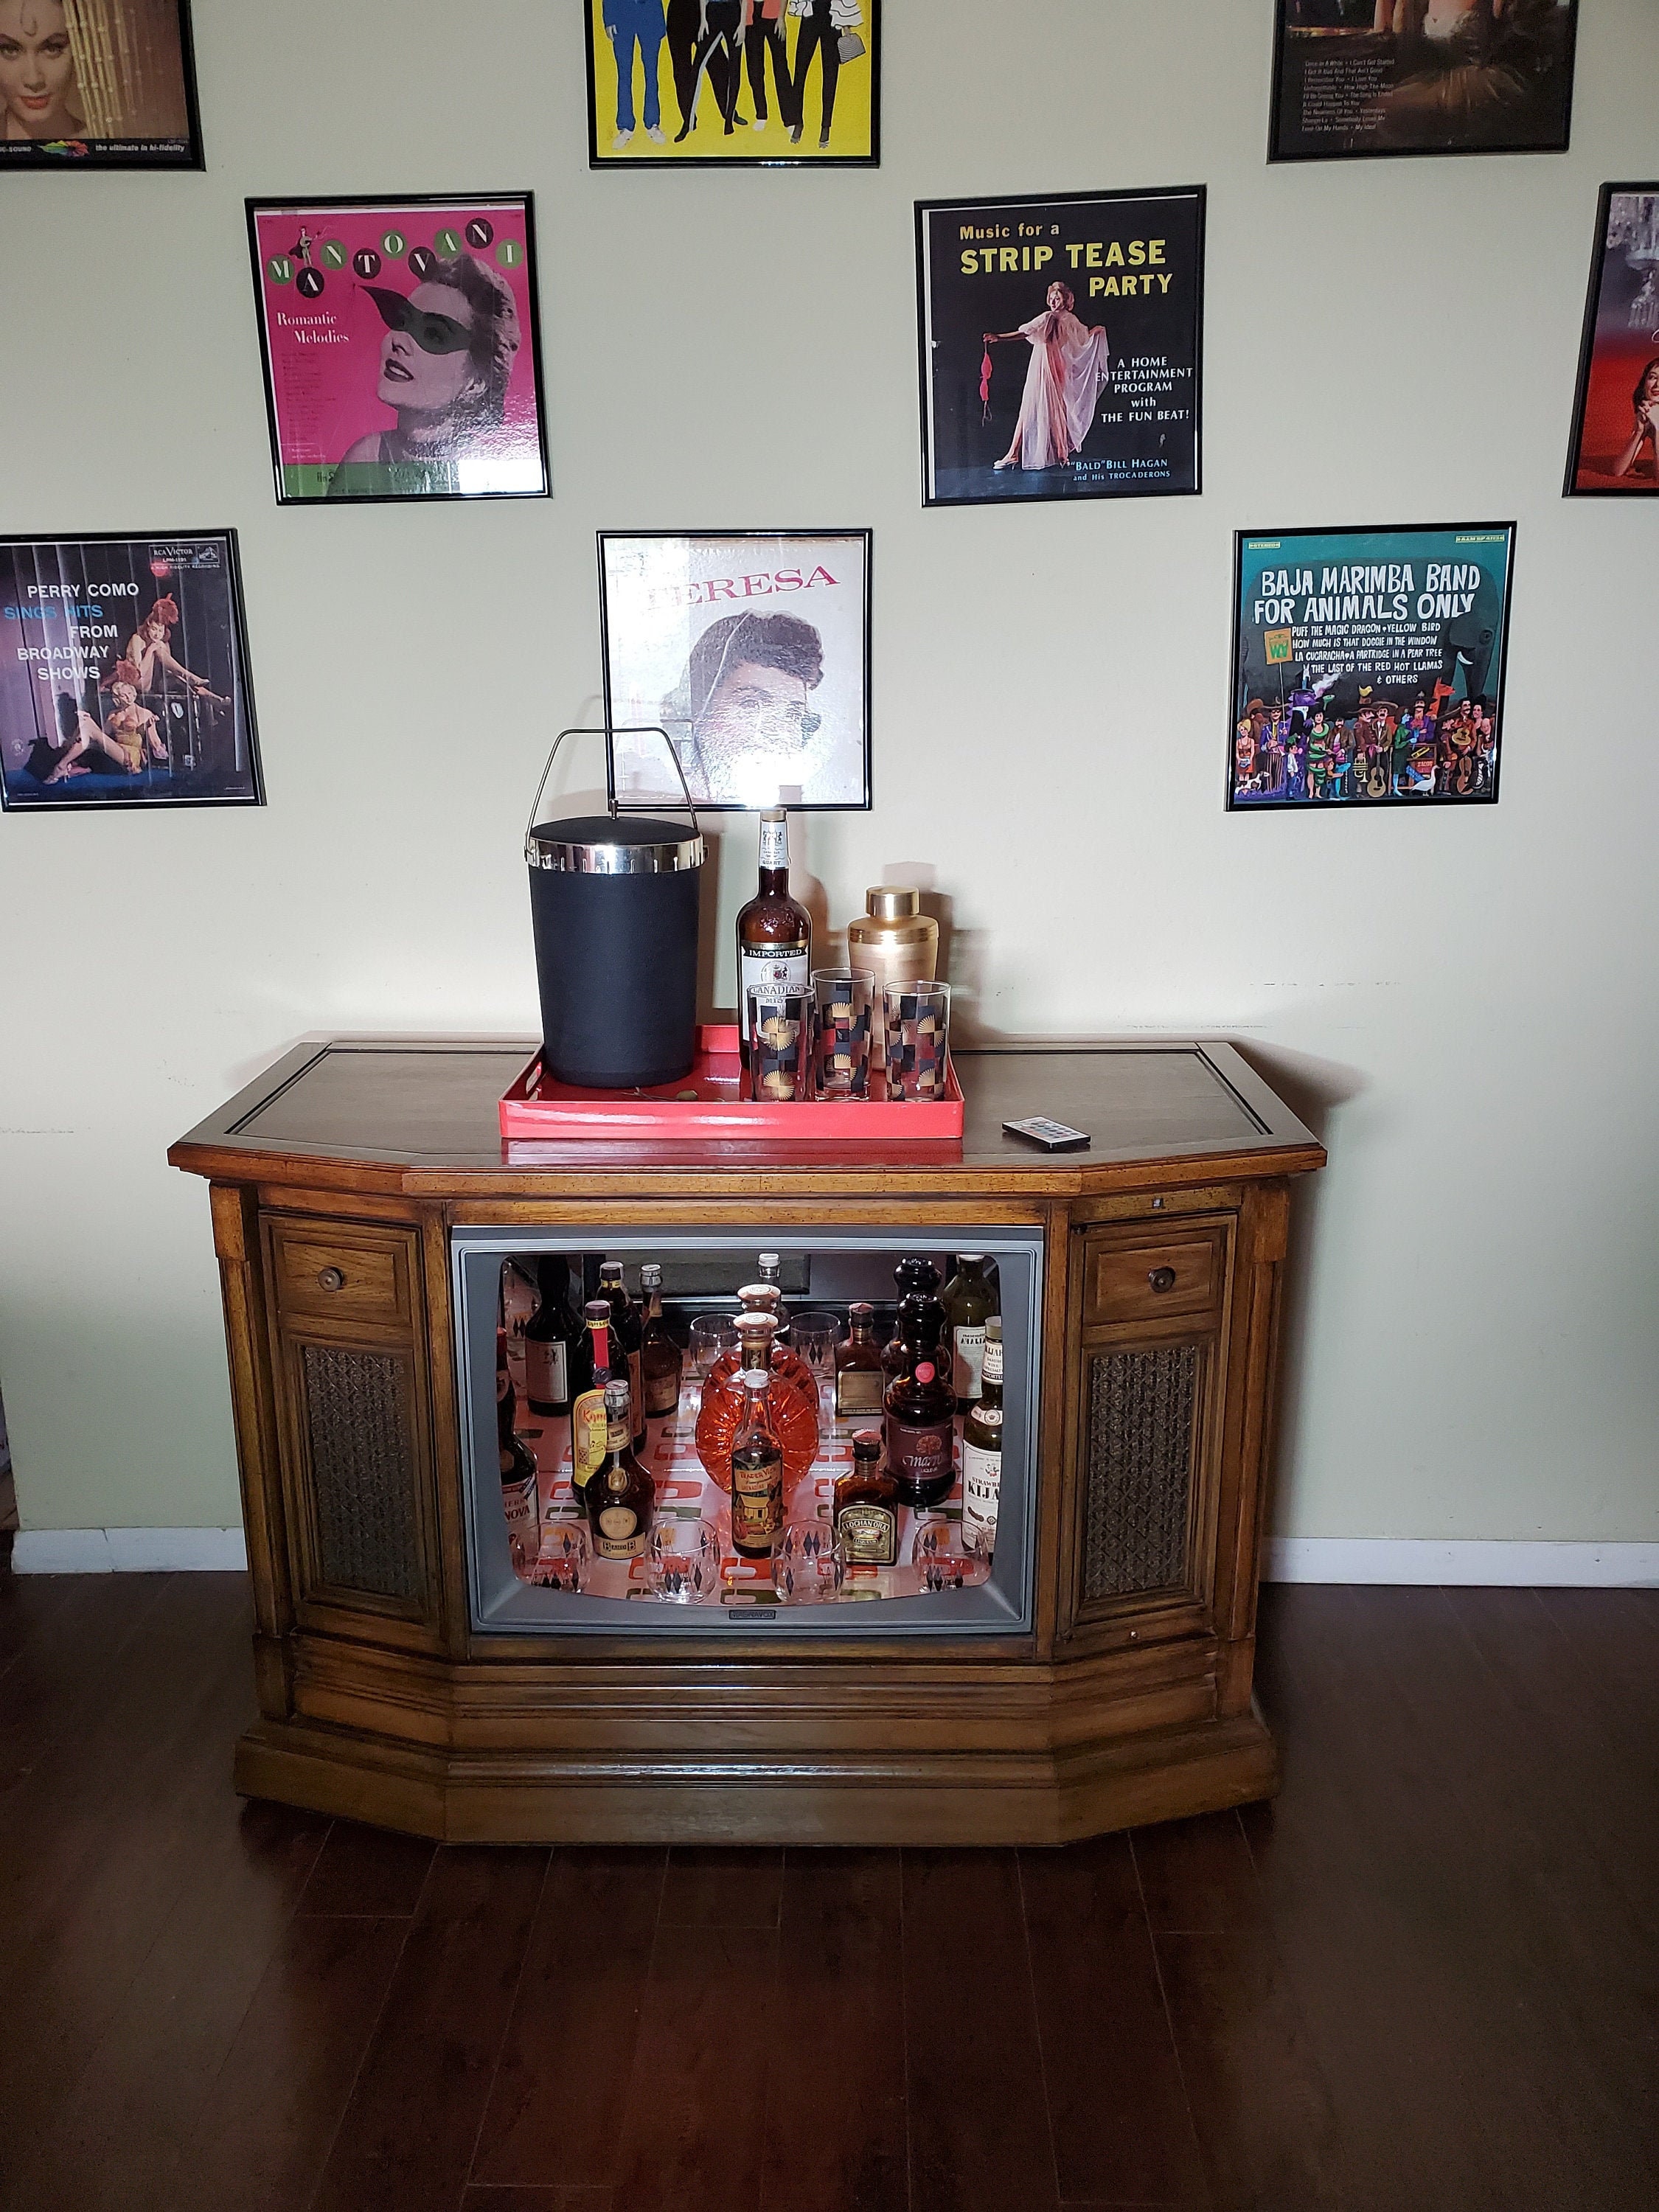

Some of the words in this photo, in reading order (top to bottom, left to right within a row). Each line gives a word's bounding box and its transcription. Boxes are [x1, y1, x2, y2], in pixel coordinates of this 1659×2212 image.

[960, 224, 1010, 240] Music
[1018, 223, 1043, 237] for
[1051, 223, 1060, 235] a
[960, 246, 1054, 274] STRIP
[1065, 240, 1166, 268] TEASE
[1089, 273, 1173, 296] PARTY
[276, 310, 337, 326] Romantic
[294, 330, 349, 344] Melodies
[1117, 358, 1125, 368] A
[1131, 356, 1168, 368] HOME
[1096, 368, 1193, 382] ENTERTAINMENT
[1114, 382, 1172, 394] PROGRAM
[1131, 397, 1156, 408] with
[1101, 412, 1123, 423] THE
[1129, 411, 1152, 422] FUN
[1158, 409, 1190, 420] BEAT!
[1132, 458, 1168, 468] HAGAN
[1108, 470, 1171, 479] TROCADERONS
[165, 546, 193, 556] VICTOR
[649, 566, 841, 606] ERESA
[1262, 568, 1313, 597] BAJA
[1321, 563, 1415, 595] MARIMBA
[1426, 563, 1481, 592] BAND
[27, 585, 80, 599] PERRY
[87, 582, 139, 598] COMO
[4, 605, 56, 619] SINGS
[1253, 599, 1295, 625] FOR
[1304, 594, 1408, 623] ANIMALS
[1417, 593, 1475, 619] ONLY
[70, 625, 118, 639] FROM
[1292, 626, 1309, 637] PUFF
[1311, 625, 1324, 636] THE
[1324, 624, 1349, 636] MAGIC
[1351, 623, 1381, 634] DRAGON
[1386, 622, 1417, 633] YELLOW
[1421, 622, 1441, 632] BIRD
[1293, 639, 1310, 649] HOW
[1312, 638, 1332, 647] MUCH
[1333, 637, 1341, 647] IS
[1343, 637, 1360, 647] THAT
[1362, 636, 1385, 647] DOGGIE
[1386, 636, 1393, 646] IN
[1394, 636, 1405, 646] THE
[1407, 636, 1438, 646] WINDOW
[17, 645, 110, 661] BROADWAY
[1295, 651, 1304, 662] LA
[1305, 650, 1346, 661] CUCARACHA
[1356, 649, 1390, 659] PARTRIDGE
[1391, 649, 1399, 658] IN
[1400, 649, 1406, 659] A
[1407, 649, 1423, 658] PEAR
[1425, 648, 1443, 658] TREE
[1310, 664, 1325, 674] THE
[1328, 663, 1344, 673] LAST
[1345, 662, 1354, 672] OF
[1357, 662, 1372, 672] THE
[1374, 661, 1391, 672] RED
[1394, 661, 1411, 671] HOT
[1413, 659, 1443, 671] LLAMAS
[37, 667, 101, 681] SHOWS
[1385, 674, 1419, 684] OTHERS
[749, 949, 802, 957] IMPORTED
[753, 985, 800, 995] CANADIAN
[873, 1523, 887, 1531] ORA
